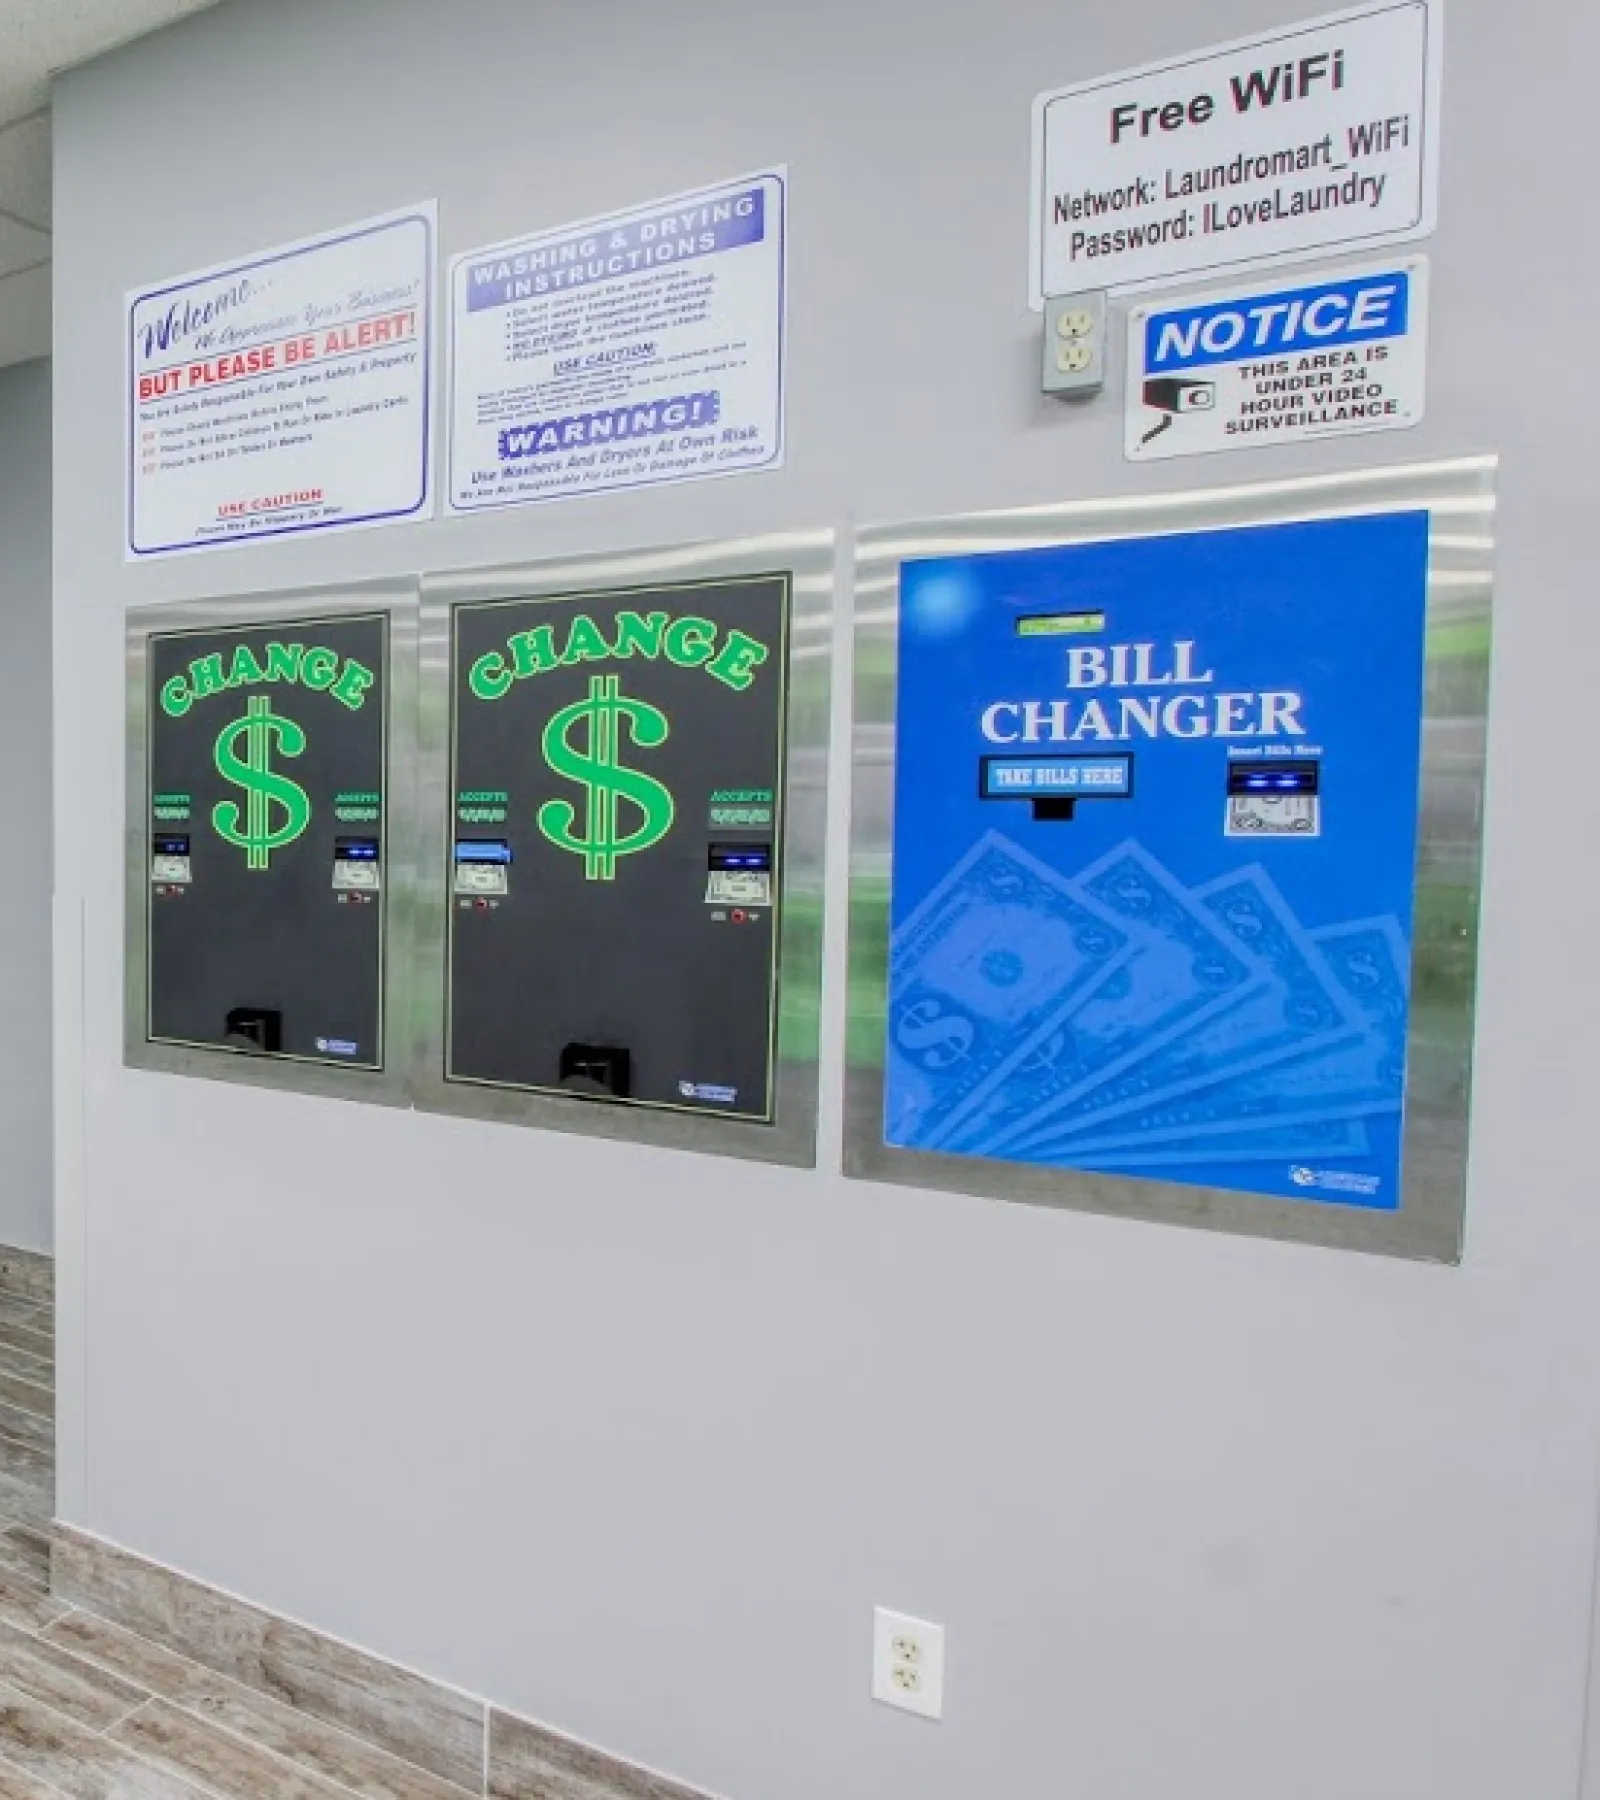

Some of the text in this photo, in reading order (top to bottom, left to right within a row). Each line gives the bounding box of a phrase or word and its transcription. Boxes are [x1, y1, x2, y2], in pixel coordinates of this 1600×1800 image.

[1110, 49, 1344, 144] Free WiFi
[1054, 113, 1409, 224] Network: Laundromart_WiFi
[473, 196, 753, 284] WASHING & DRYING
[1070, 173, 1386, 261] Password: ILoveLaundry
[505, 231, 715, 300] INSTRUCTIONS
[1154, 286, 1397, 362] NOTICE
[139, 311, 415, 400] BUT PLEASE BE ALERT!
[1239, 346, 1389, 379] THIS AREA IS
[1256, 367, 1367, 394] UNDER 24
[507, 402, 700, 452] WARNING!
[1225, 399, 1397, 434] SURVEILLANCE
[1241, 384, 1382, 415] HOUR VIDEO
[472, 425, 758, 484] Use Washers And Dryers At Own Risk
[218, 489, 322, 517] USE CAUTION
[160, 642, 374, 717] CHANGE
[469, 611, 769, 700] CHANGE
[1066, 640, 1213, 688] BILL
[980, 691, 1306, 743] CHANGER
[997, 767, 1122, 785] TAKE BILLS HERE
